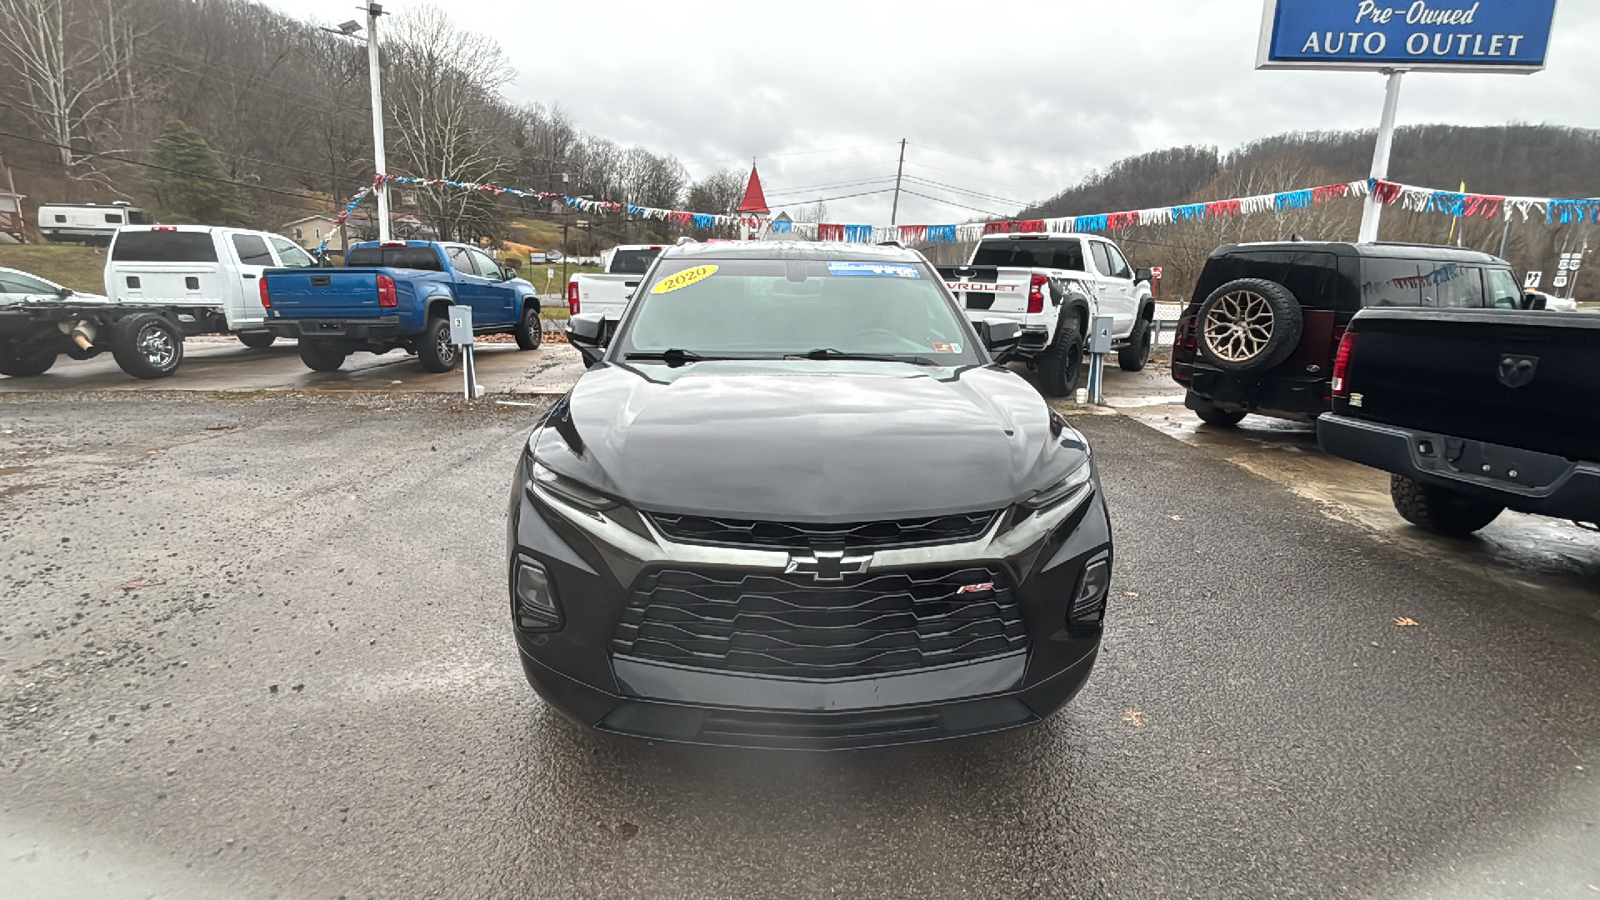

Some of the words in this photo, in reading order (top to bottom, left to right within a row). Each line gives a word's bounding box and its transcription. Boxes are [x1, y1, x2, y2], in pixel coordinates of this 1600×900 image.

[1354, 0, 1480, 25] Pre-Owned
[1301, 31, 1387, 54] AUTO
[1405, 32, 1524, 56] OUTLET
[664, 267, 707, 290] 2020
[946, 282, 1020, 292] VROLET
[956, 582, 994, 594] RS
